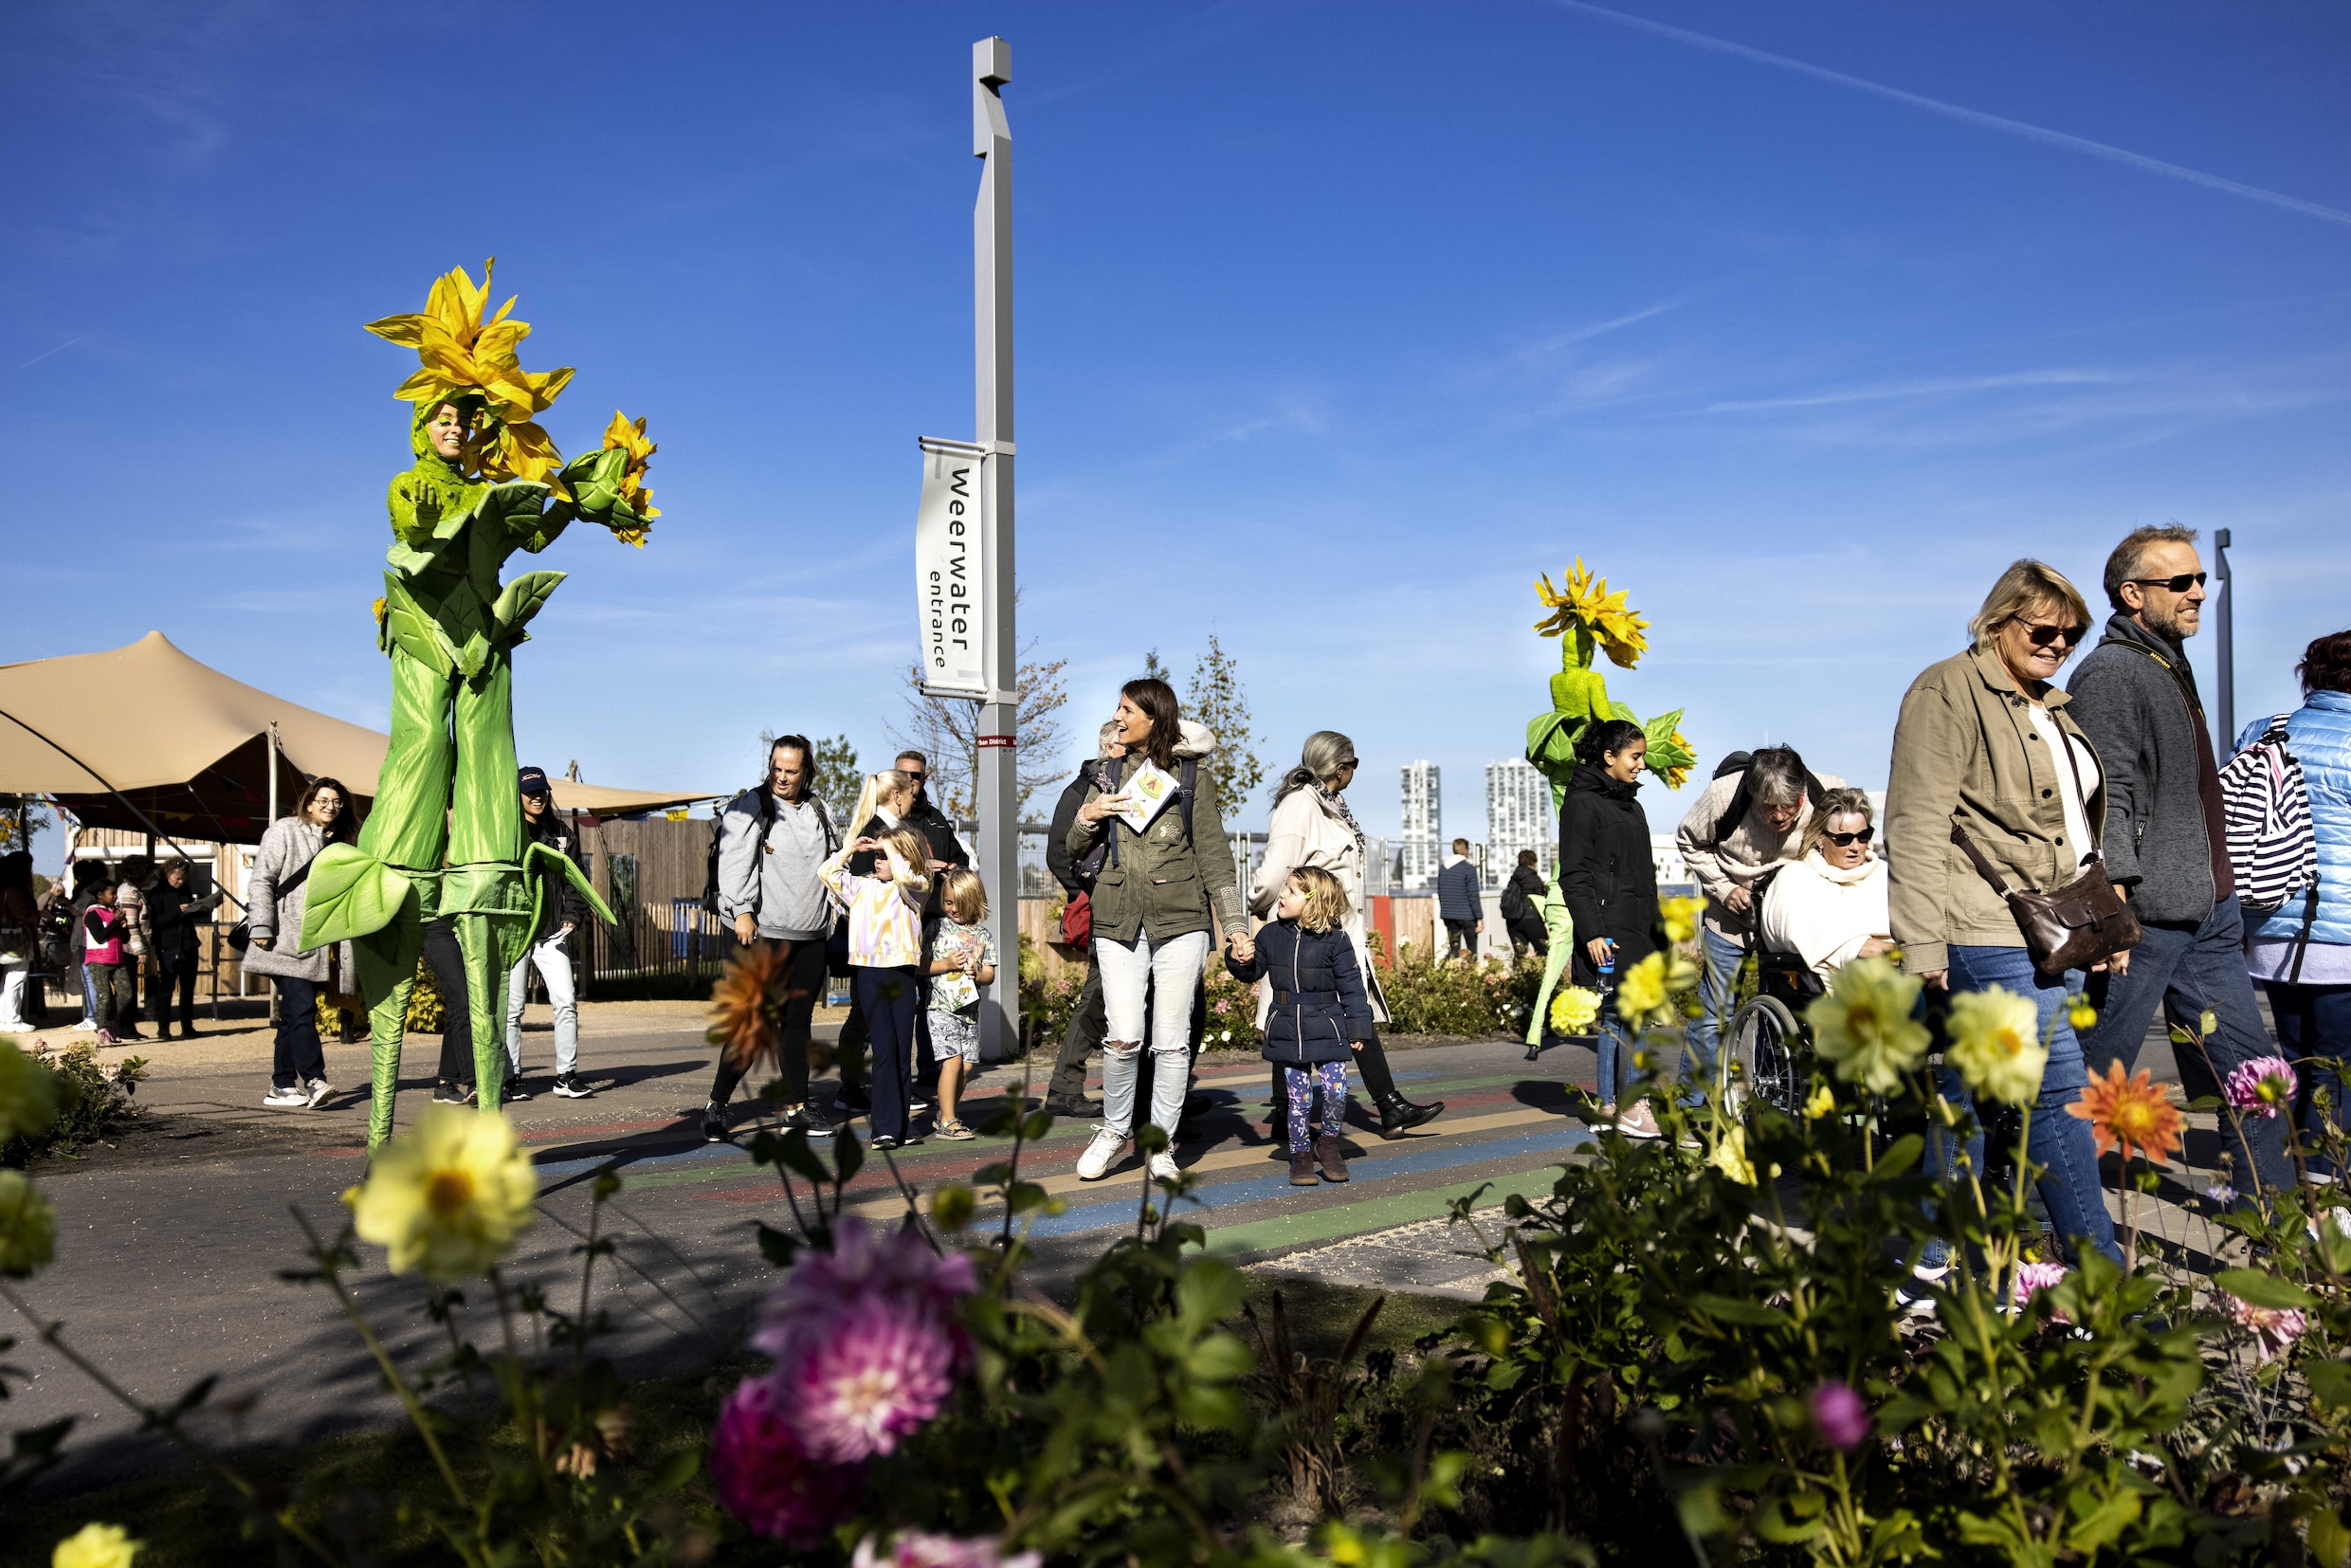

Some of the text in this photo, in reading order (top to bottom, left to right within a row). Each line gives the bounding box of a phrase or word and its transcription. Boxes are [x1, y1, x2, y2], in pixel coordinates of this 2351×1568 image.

[949, 467, 971, 650] Weerwater
[930, 571, 945, 667] entrance
[2150, 651, 2171, 669] Nikon
